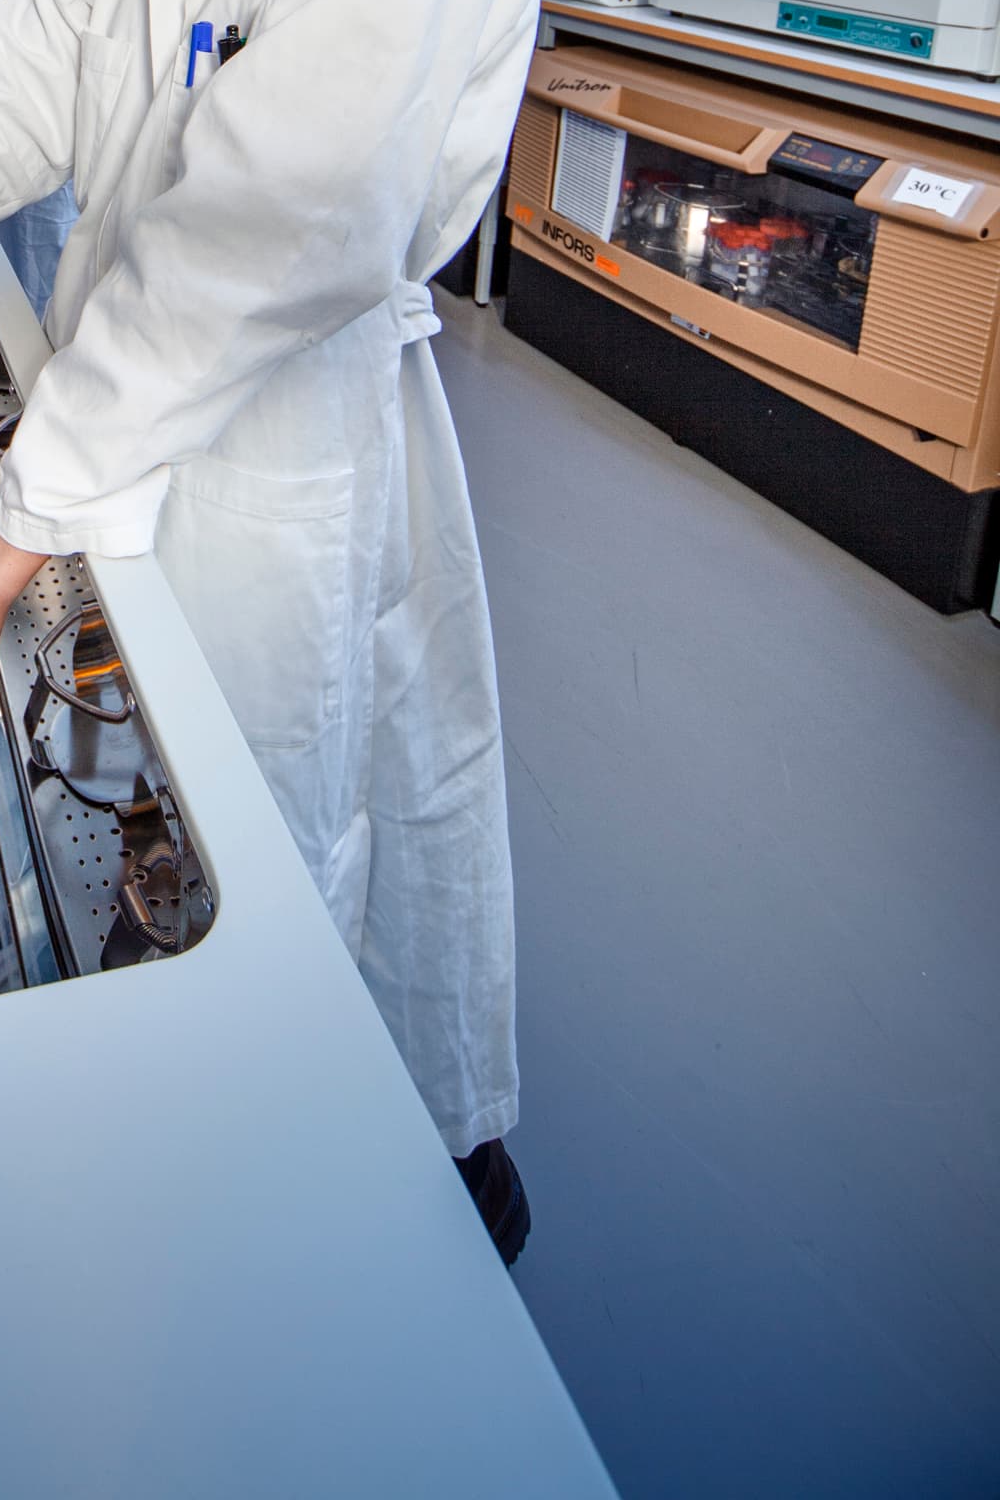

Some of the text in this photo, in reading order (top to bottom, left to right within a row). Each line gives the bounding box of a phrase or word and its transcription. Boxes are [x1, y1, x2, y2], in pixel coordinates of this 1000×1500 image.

[547, 78, 612, 92] Unitron
[908, 180, 930, 193] 30
[542, 219, 595, 262] INFORS
